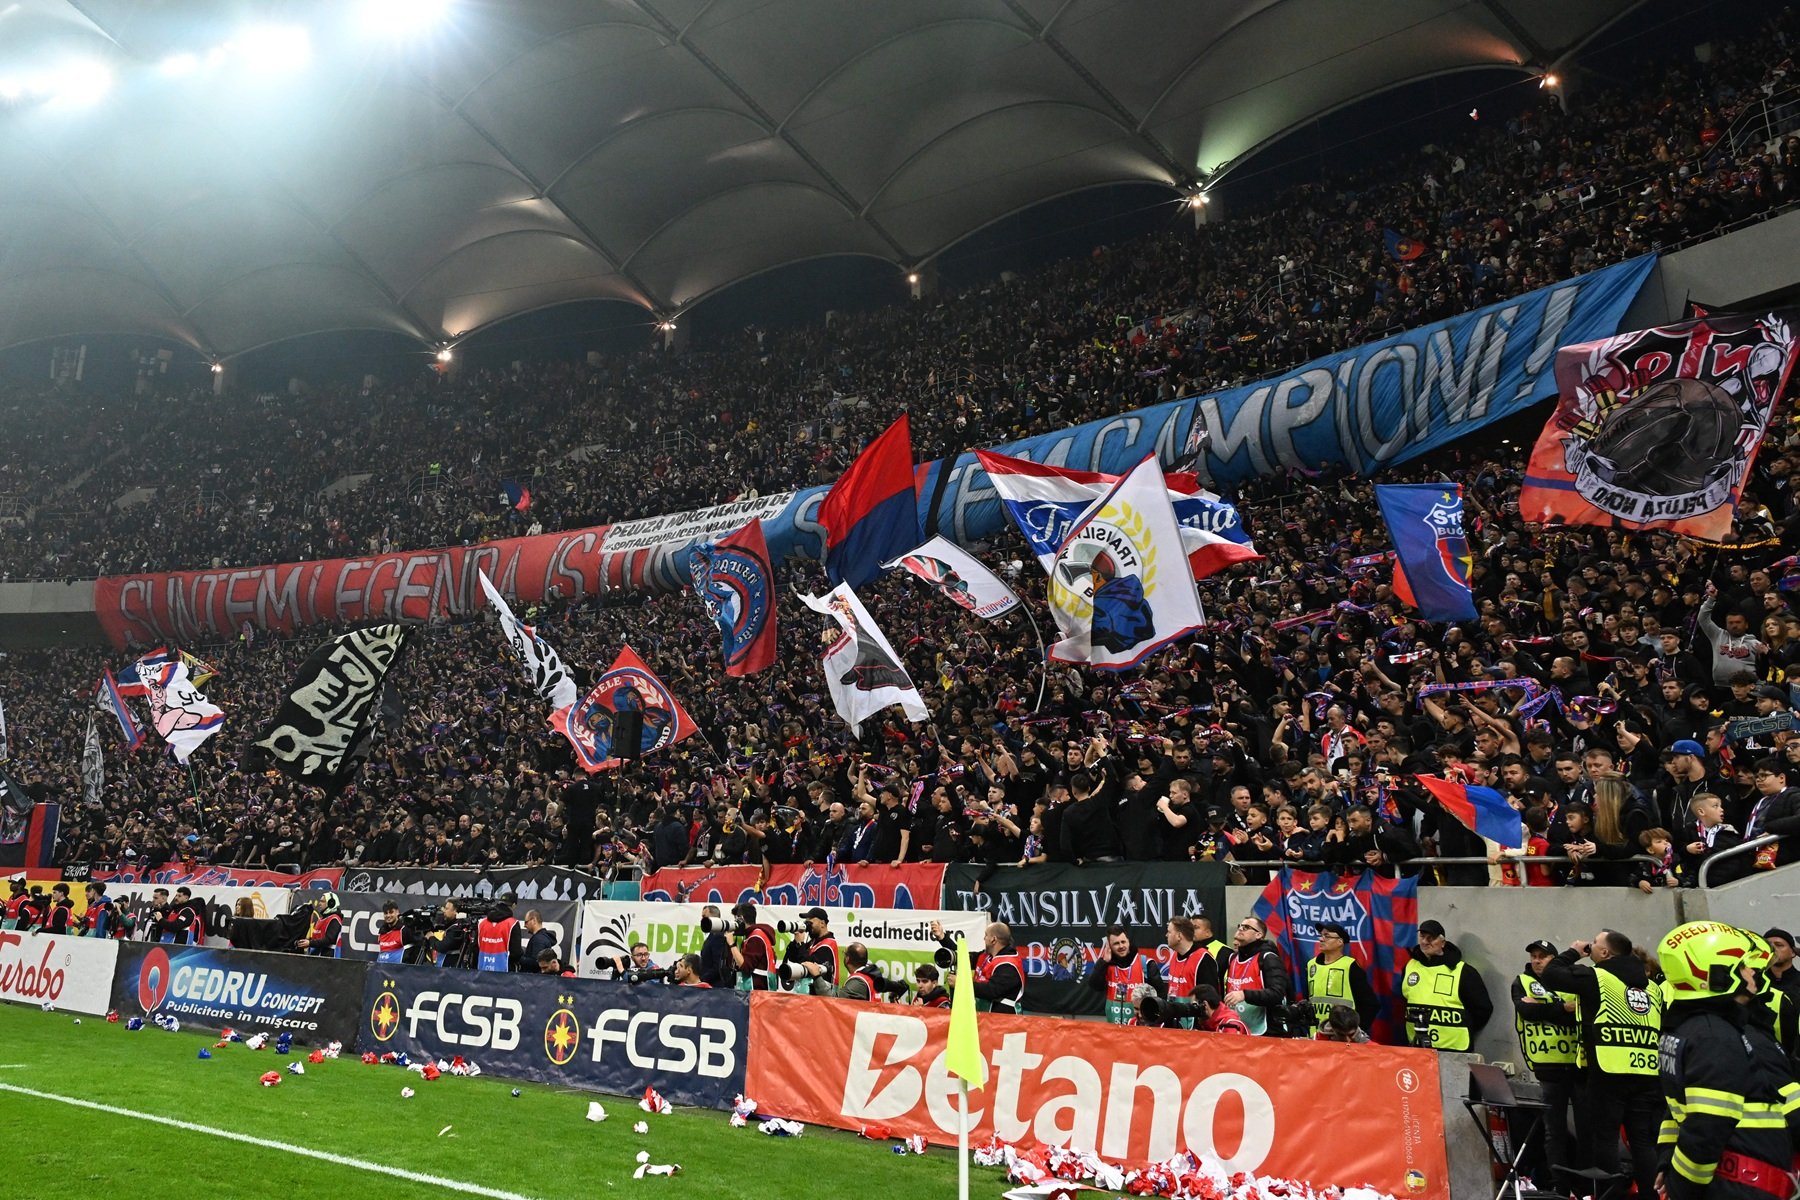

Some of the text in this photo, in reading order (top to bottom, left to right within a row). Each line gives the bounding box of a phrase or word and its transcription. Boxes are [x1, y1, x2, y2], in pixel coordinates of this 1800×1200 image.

[609, 518, 663, 539] PELUZA
[580, 676, 622, 713] FETELE
[655, 726, 671, 749] ORD
[957, 882, 1206, 928] TRANSILVANIA
[1288, 895, 1357, 923] STEAUA
[646, 923, 702, 954] IDEA
[1666, 924, 1708, 950] SPEED
[1710, 923, 1741, 938] FIRE
[172, 966, 325, 1015] CEDRU CONCEPT
[1627, 988, 1648, 1004] SAS
[165, 1000, 235, 1021] Publicitate
[1630, 1001, 1649, 1010] TEAM
[1601, 1026, 1659, 1046] STEWA
[839, 1011, 1275, 1175] Betano
